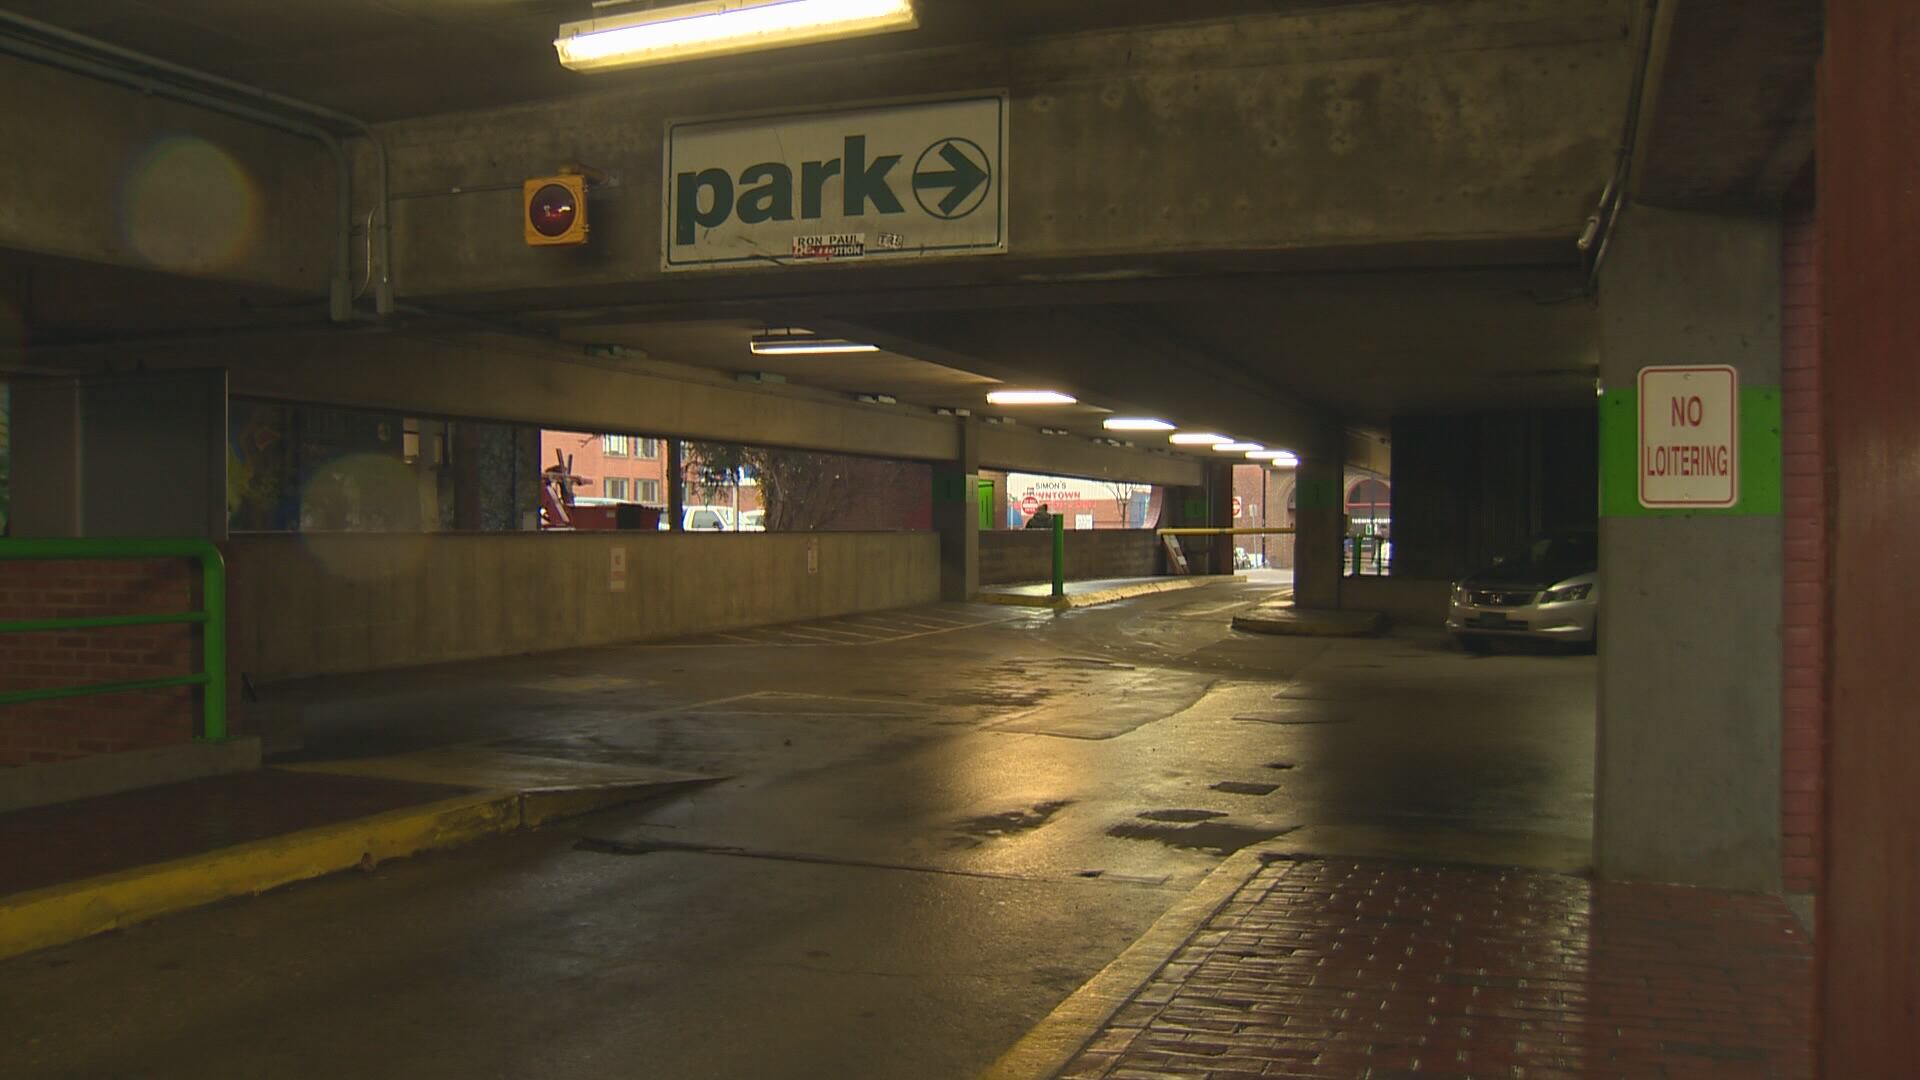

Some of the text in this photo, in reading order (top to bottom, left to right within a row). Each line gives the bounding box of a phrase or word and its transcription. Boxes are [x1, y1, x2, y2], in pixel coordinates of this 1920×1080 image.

[676, 135, 905, 245] park
[798, 234, 860, 246] RON PAUL
[1671, 395, 1703, 427] NO
[1647, 445, 1728, 476] LOITERING
[1022, 491, 1081, 499] WNTOWN
[1035, 480, 1067, 490] SIMON'S
